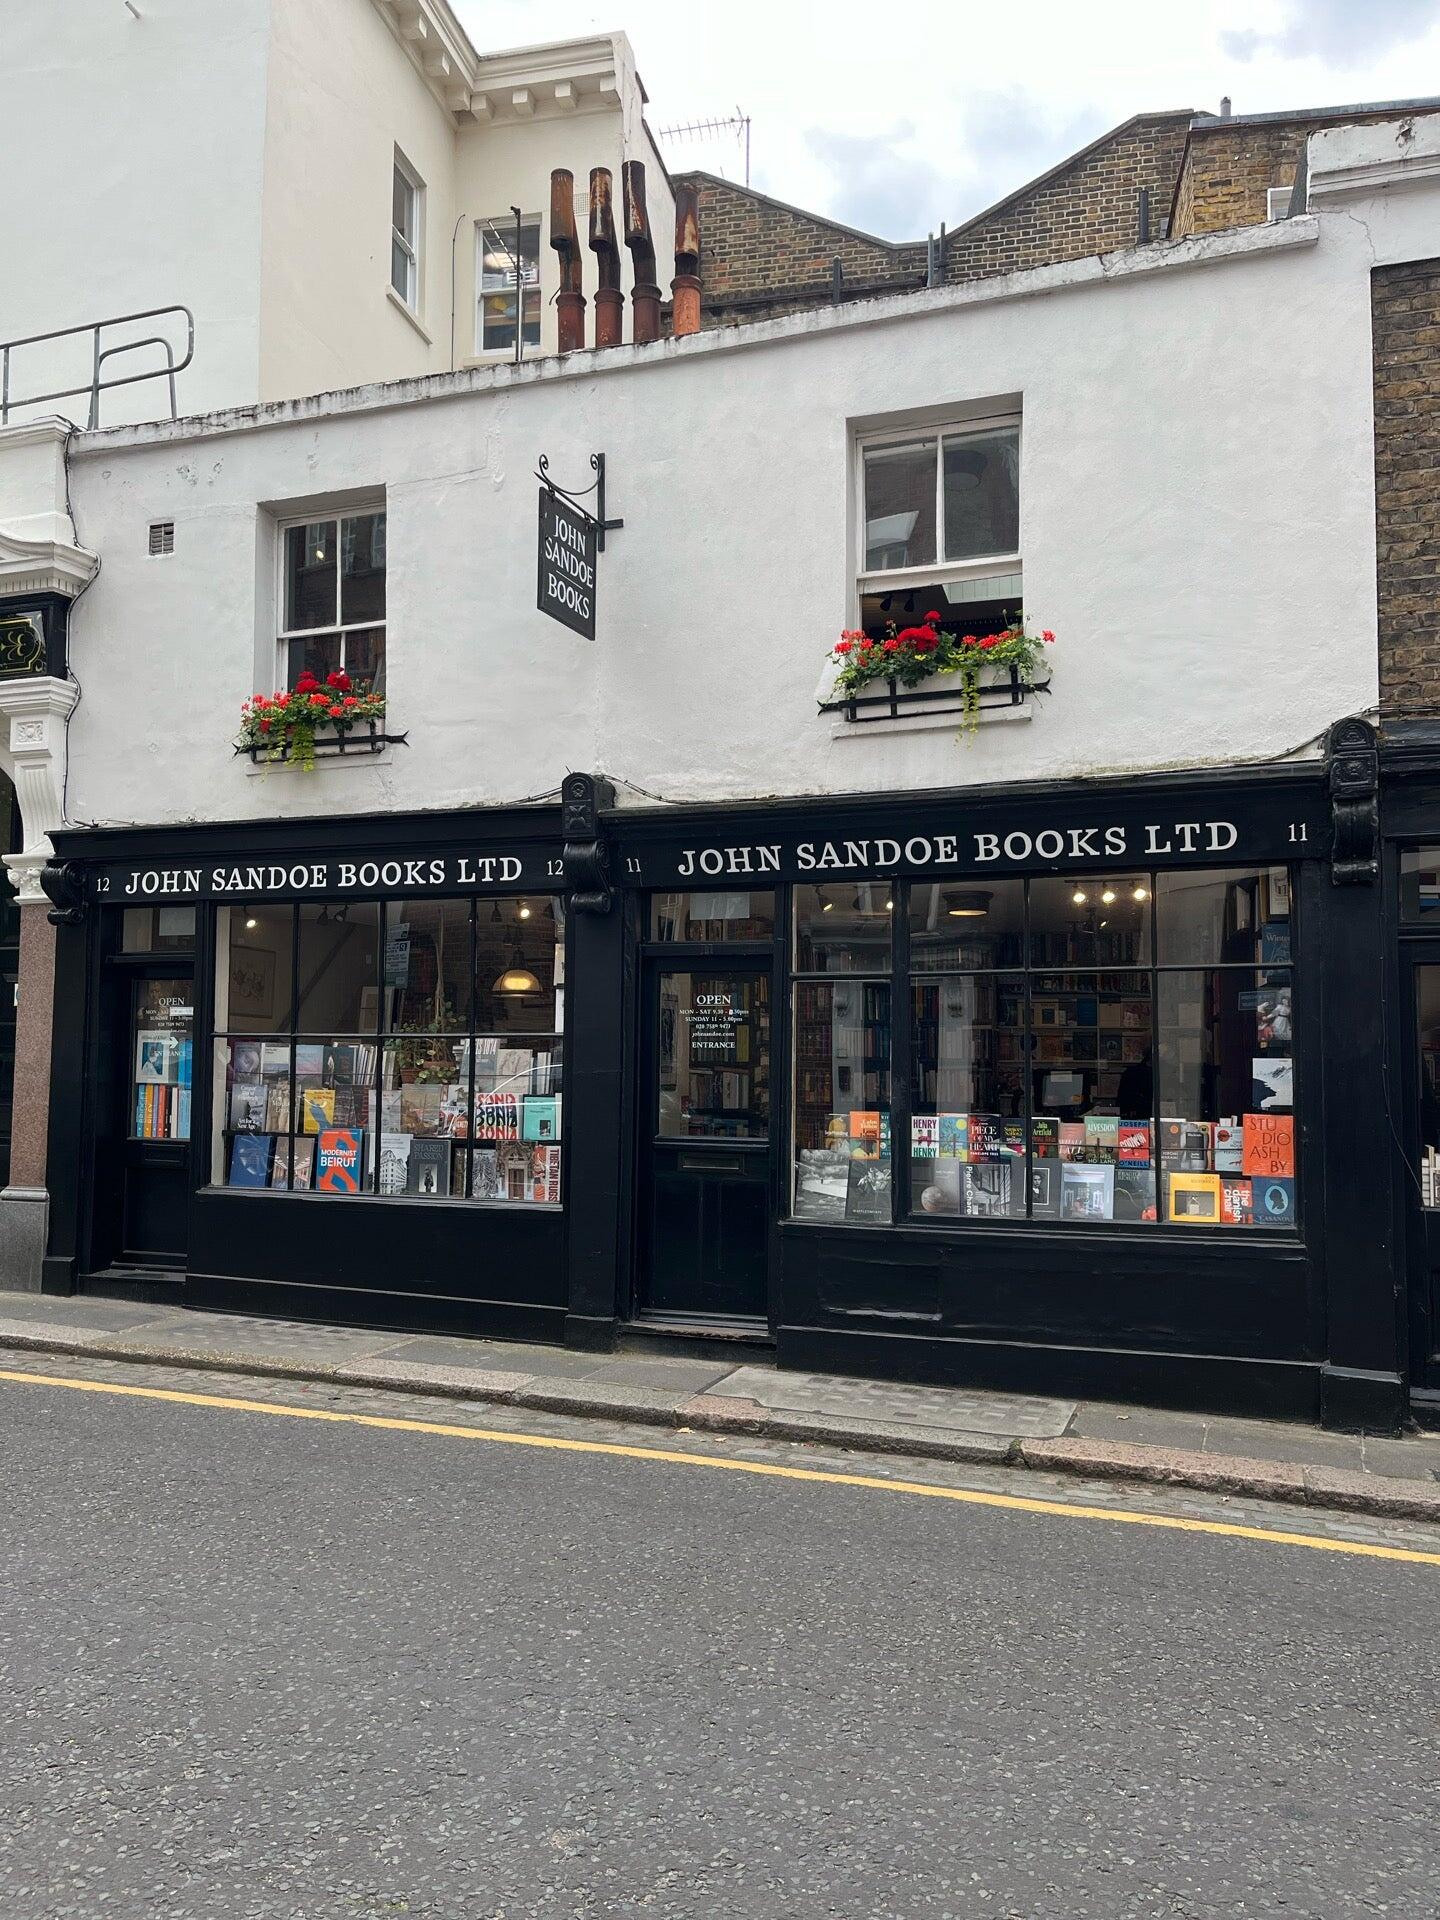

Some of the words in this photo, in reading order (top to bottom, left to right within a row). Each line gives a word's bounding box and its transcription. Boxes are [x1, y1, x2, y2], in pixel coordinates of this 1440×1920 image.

[554, 515, 586, 556] JOHN
[545, 536, 594, 588] SANDOE
[548, 572, 590, 619] BOOKS
[1288, 823, 1309, 842] 11
[677, 845, 782, 876] JOHN
[796, 835, 959, 870] SANDOE
[973, 826, 1127, 862] BOOKS
[1144, 821, 1238, 854] LTD
[546, 859, 564, 876] 12
[625, 857, 642, 873] 11
[125, 869, 203, 895] JOHN
[211, 864, 328, 891] SANDOE
[337, 859, 446, 888] BOOKS
[457, 856, 523, 883] LTD
[96, 877, 110, 892] 12
[158, 997, 185, 1006] OPEN
[696, 994, 732, 1005] OPEN
[464, 1038, 482, 1055] PIS
[692, 1041, 736, 1049] ENTRANCE
[913, 1119, 937, 1129] HENRY
[971, 1125, 997, 1135] PIECE
[1250, 1118, 1277, 1131] STU
[476, 1126, 519, 1140] SONIA
[1262, 1132, 1290, 1146] DIO
[321, 1149, 357, 1157] MODERNIST
[913, 1147, 937, 1157] HENRY
[969, 1143, 1000, 1151] HEART
[1250, 1146, 1280, 1159] ASH
[320, 1156, 357, 1168] BEIRUT
[549, 1149, 559, 1180] TIBETAN
[1270, 1160, 1287, 1173] BY
[549, 1180, 558, 1203] RUGS
[1241, 1190, 1249, 1207] the
[1224, 1189, 1232, 1212] chair
[1232, 1189, 1242, 1223] danish
[1259, 1214, 1291, 1222] CASANOV
